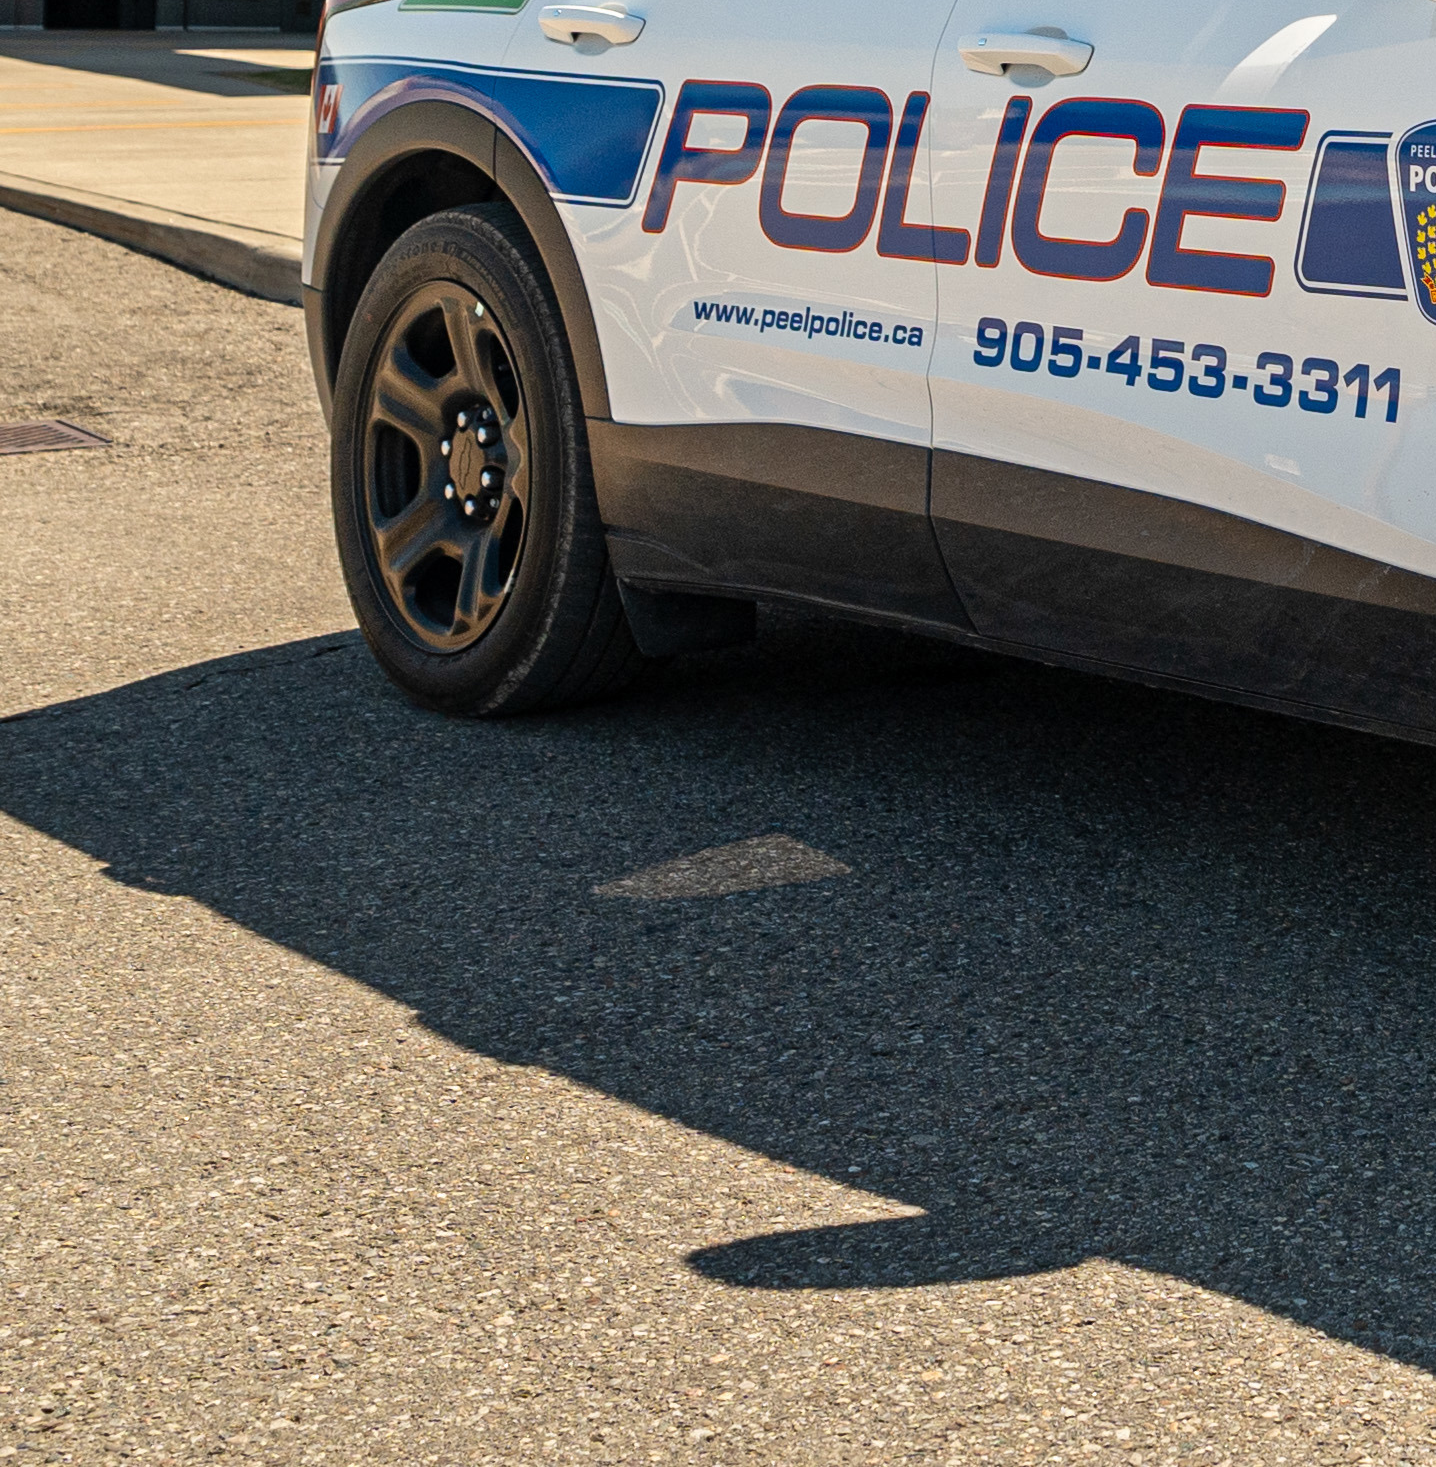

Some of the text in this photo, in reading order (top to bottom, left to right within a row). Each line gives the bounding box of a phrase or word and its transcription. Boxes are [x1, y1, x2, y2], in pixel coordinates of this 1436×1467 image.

[642, 78, 1310, 297] POLICE
[1410, 144, 1436, 158] PEEL
[693, 300, 925, 347] www.peelpolice.ca
[973, 316, 1402, 424] 905-453-3311
